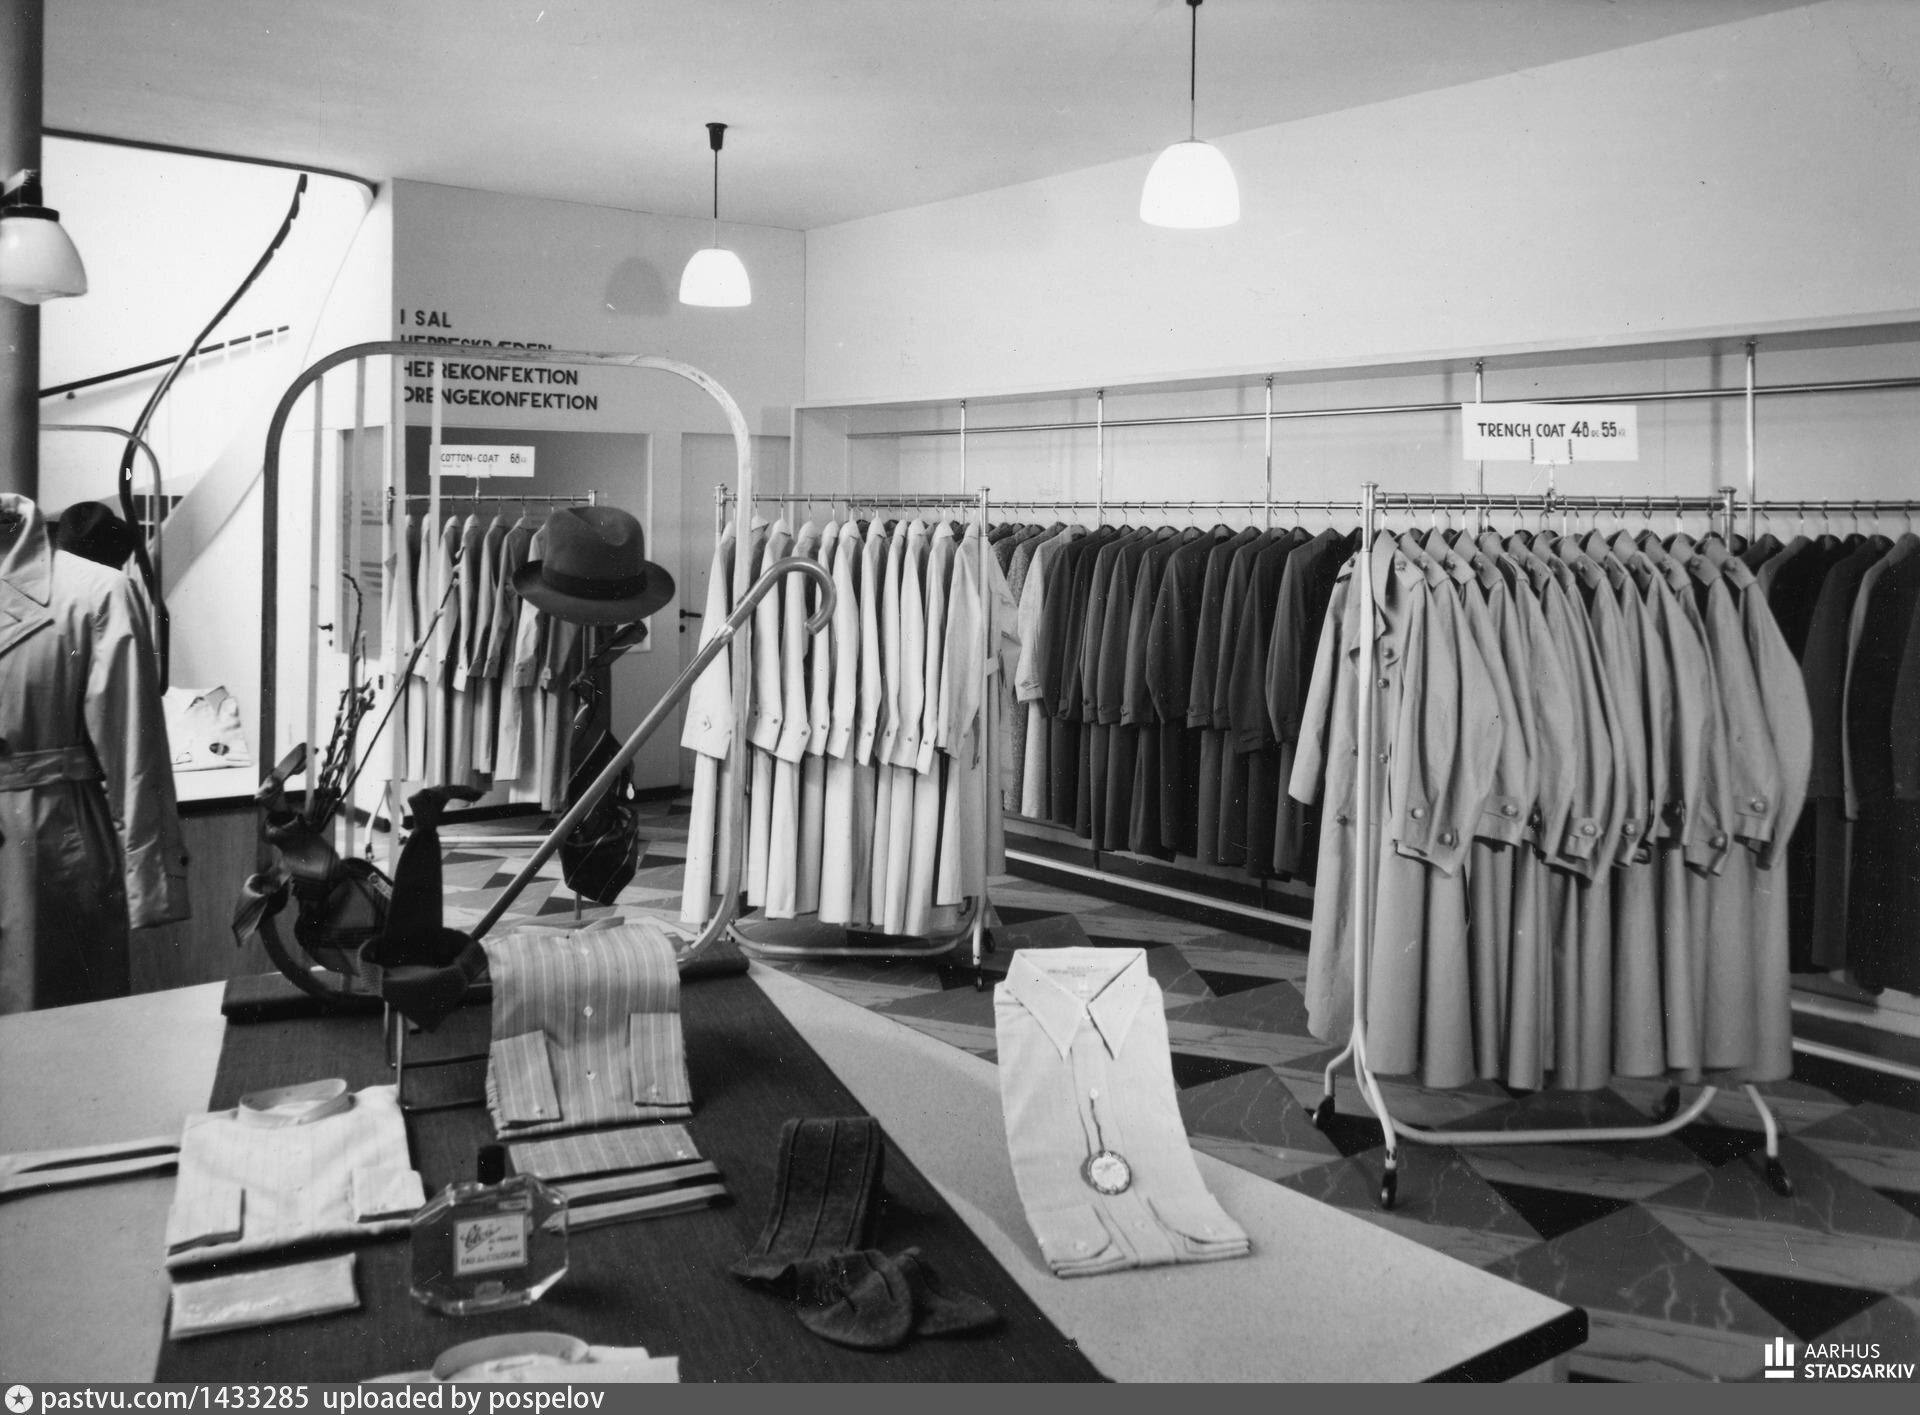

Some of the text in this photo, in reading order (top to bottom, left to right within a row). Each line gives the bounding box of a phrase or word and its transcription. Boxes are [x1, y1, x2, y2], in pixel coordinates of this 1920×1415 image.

[415, 310, 452, 328] SAL
[1477, 422, 1531, 437] TRENCH
[1536, 423, 1566, 437] COAT
[1571, 421, 1589, 437] 48
[1601, 421, 1617, 437] 55
[440, 453, 499, 462] COTTON-COAT
